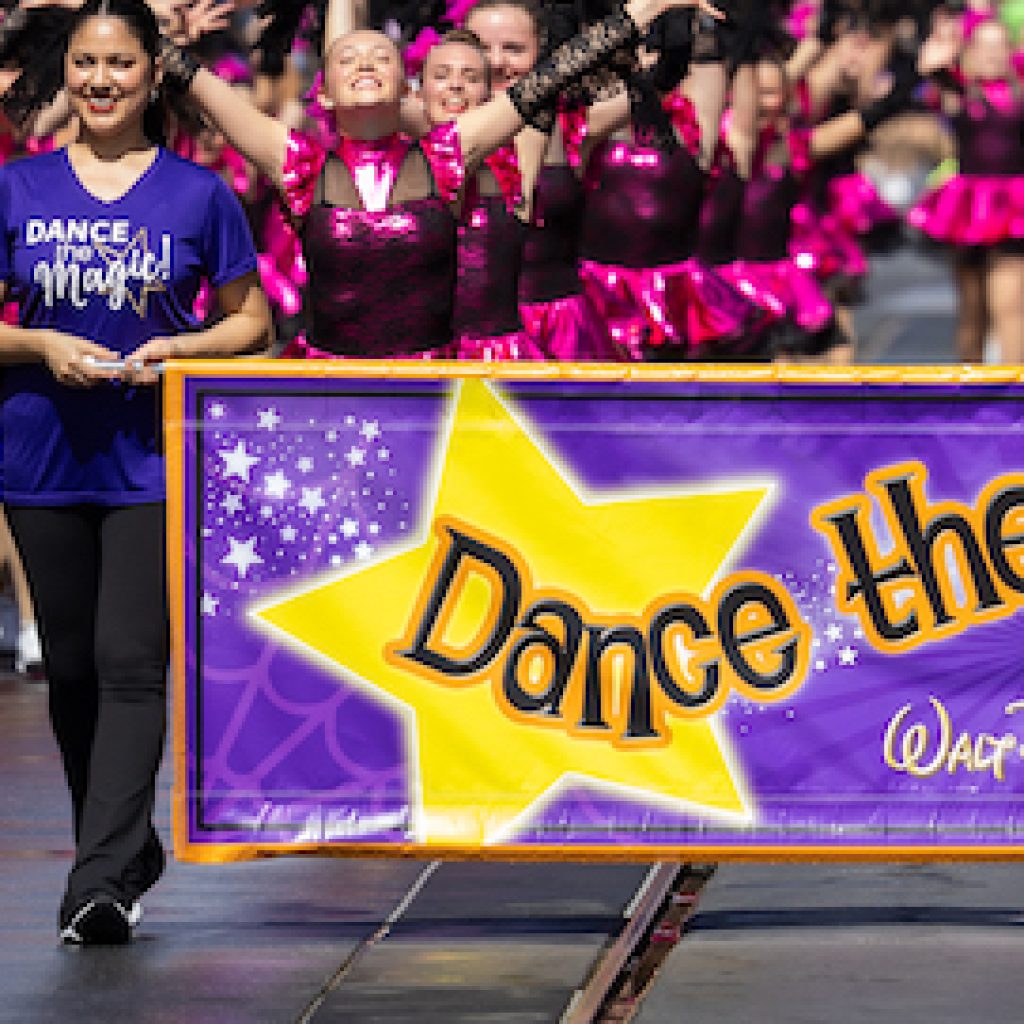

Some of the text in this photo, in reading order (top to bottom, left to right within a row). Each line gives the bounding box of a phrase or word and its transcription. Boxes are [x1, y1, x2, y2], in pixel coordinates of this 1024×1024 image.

[26, 219, 129, 246] DANCE
[33, 233, 171, 310] Magic!
[390, 522, 803, 741] Dance
